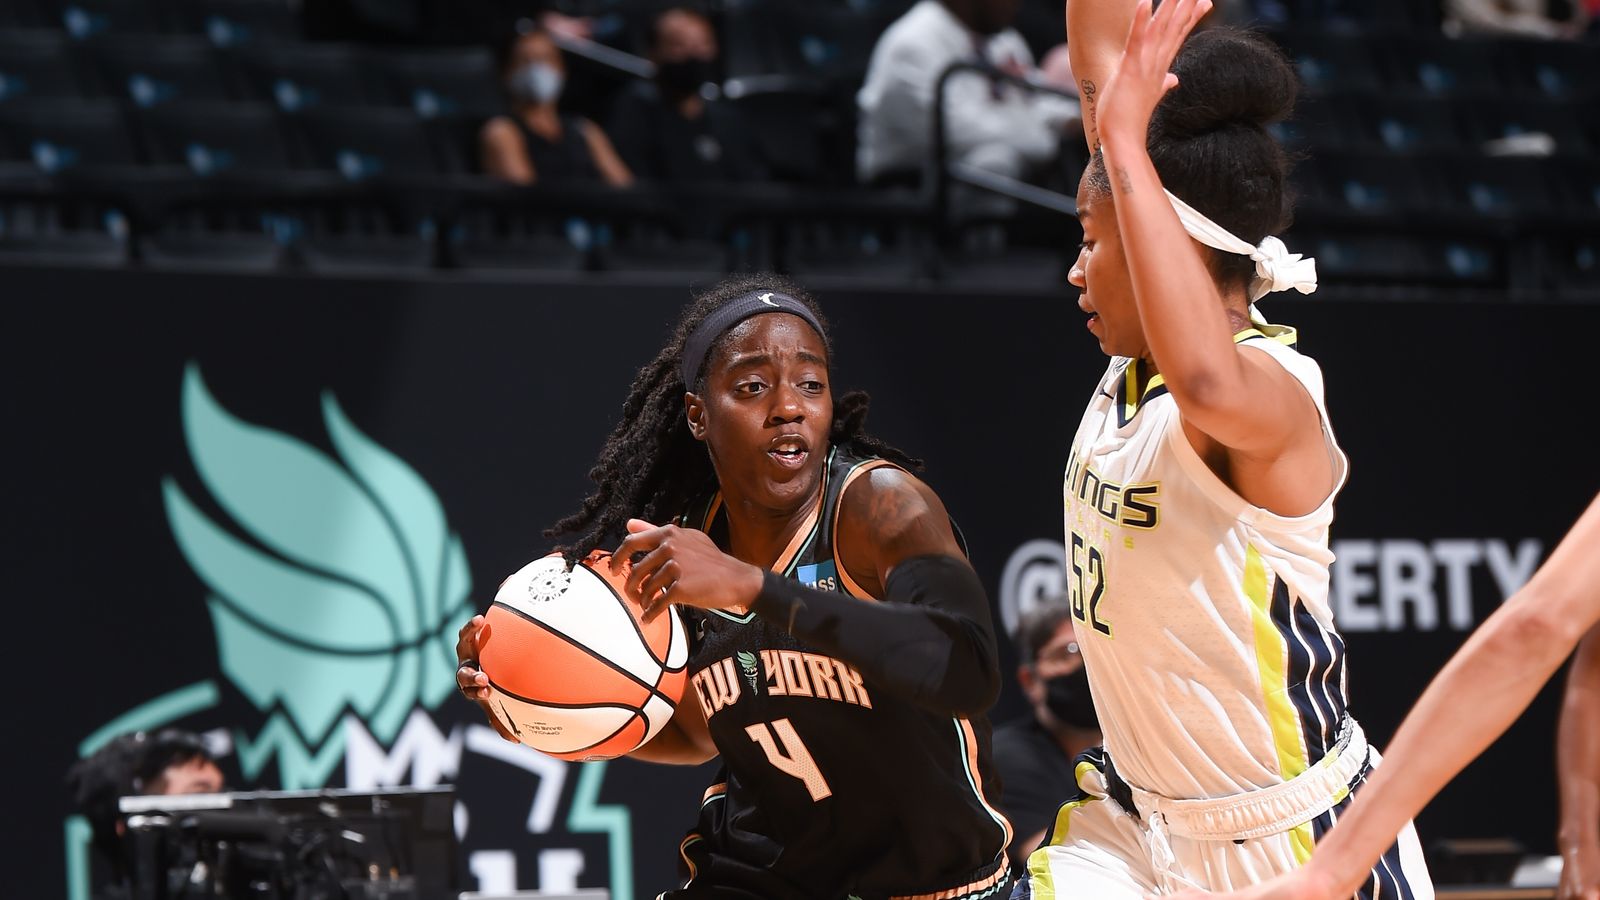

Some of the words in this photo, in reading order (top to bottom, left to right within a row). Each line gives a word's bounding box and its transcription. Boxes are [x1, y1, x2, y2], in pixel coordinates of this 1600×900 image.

[1070, 529, 1113, 639] 52
[1332, 538, 1544, 632] ERTY
[690, 655, 742, 722] EW
[759, 649, 872, 710] YORK
[744, 717, 833, 802] 4
